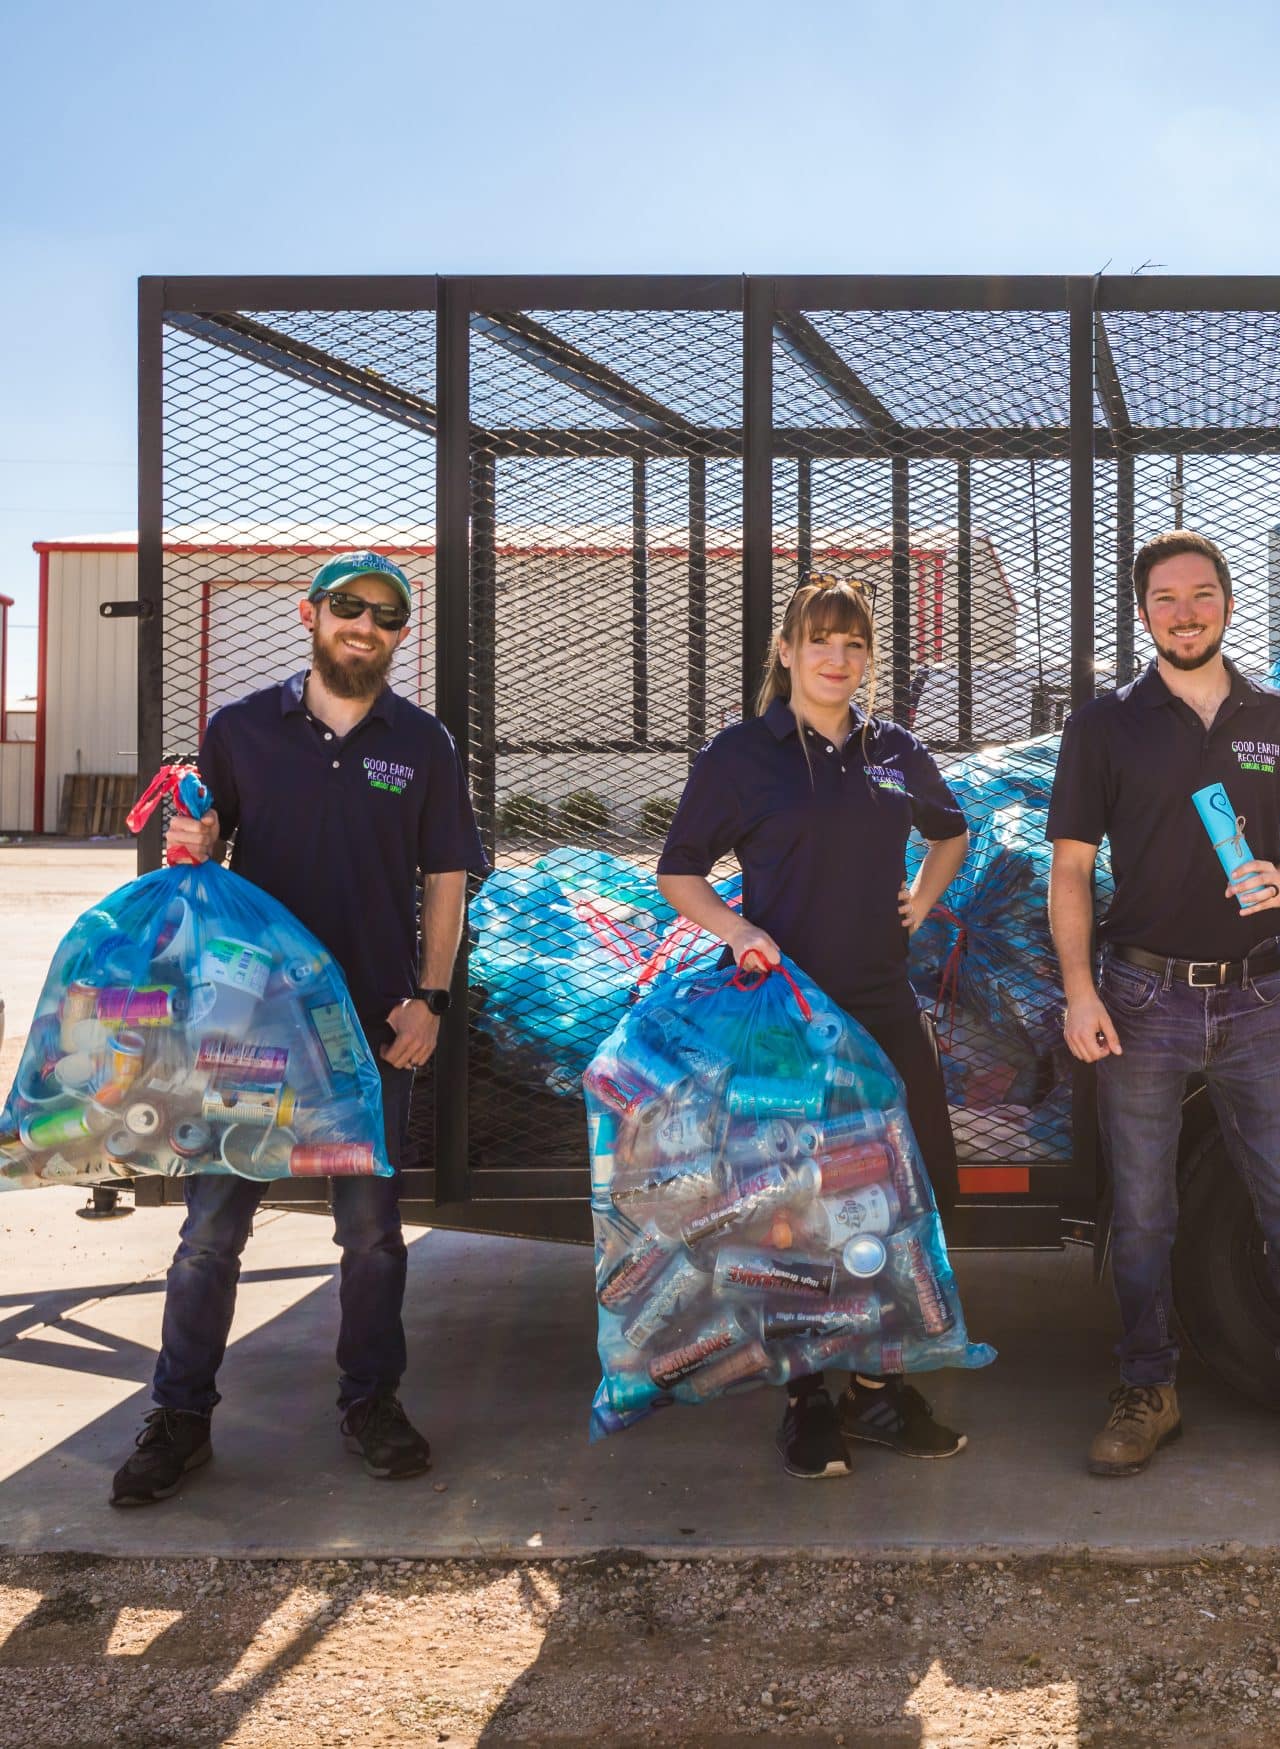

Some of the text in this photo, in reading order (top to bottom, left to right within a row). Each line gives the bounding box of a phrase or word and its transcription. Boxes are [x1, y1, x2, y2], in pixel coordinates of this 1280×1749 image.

[1232, 741, 1280, 757] GOOD EARTH
[1238, 753, 1276, 765] RECYCLING
[363, 757, 415, 780] GOOD EARTH
